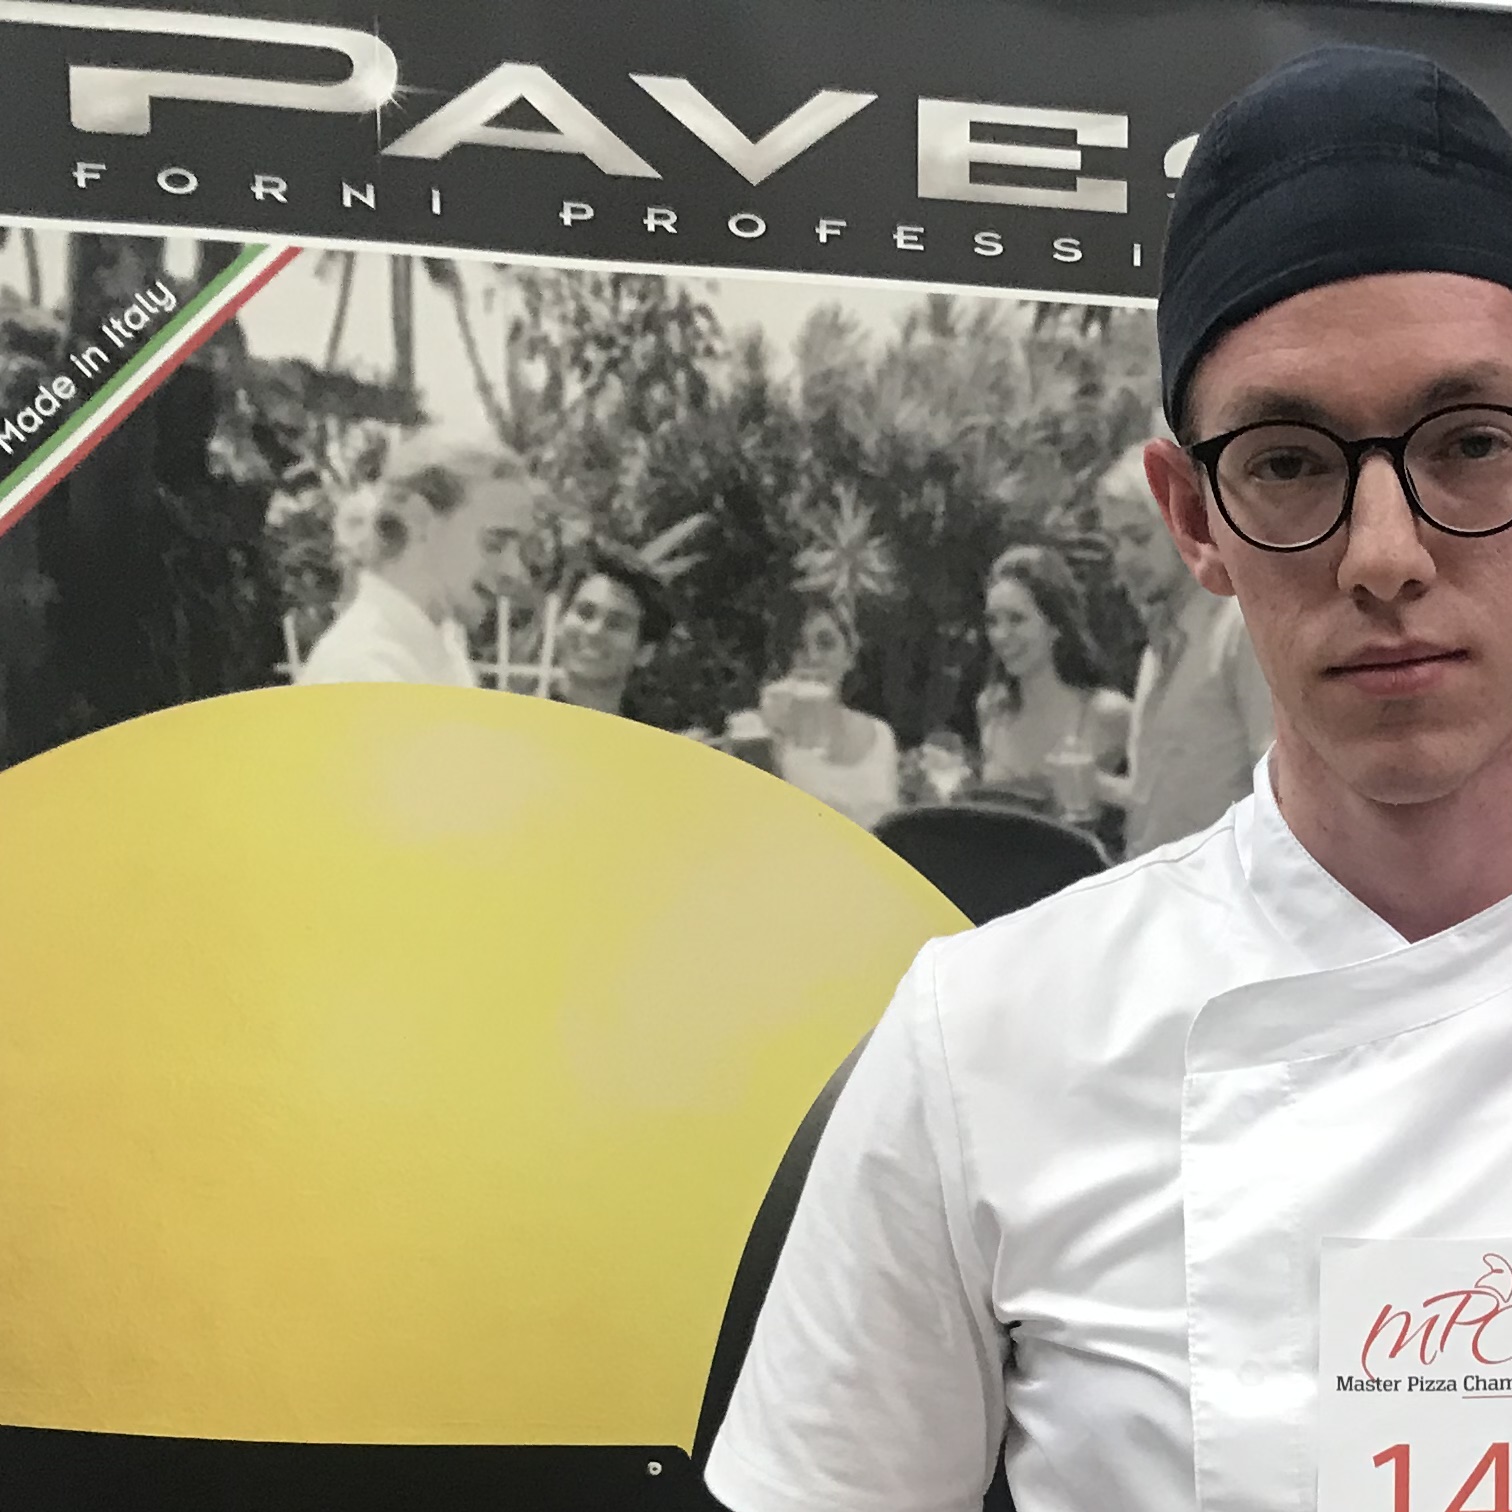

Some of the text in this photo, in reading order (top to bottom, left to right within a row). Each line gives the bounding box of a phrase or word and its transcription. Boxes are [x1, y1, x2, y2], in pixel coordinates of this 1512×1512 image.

[0, 0, 1199, 213] PAVE
[73, 162, 1142, 267] FORNI PROFESSI
[0, 279, 178, 455] Made in Italy
[1336, 1376, 1401, 1392] Master
[1407, 1376, 1457, 1392] Pizza
